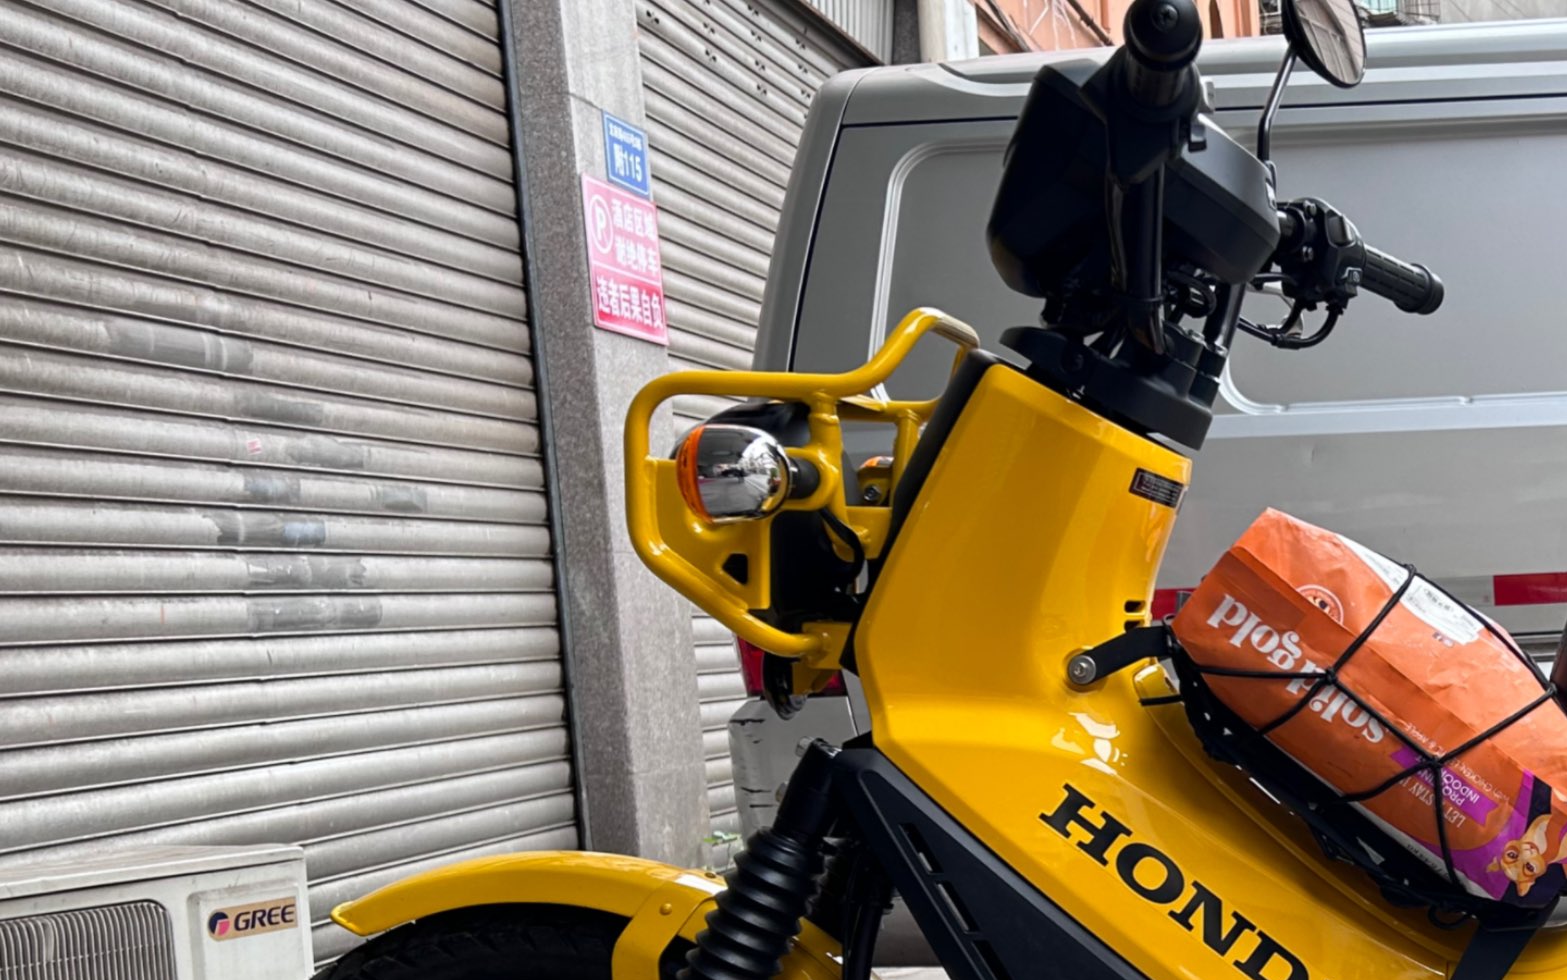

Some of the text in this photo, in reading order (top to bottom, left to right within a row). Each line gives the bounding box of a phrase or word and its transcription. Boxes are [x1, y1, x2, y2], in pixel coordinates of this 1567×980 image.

[614, 235, 659, 276] 谢绝停车
[596, 275, 663, 329] 违者后果自负
[1206, 593, 1385, 743] solid gold
[1407, 780, 1436, 807] STAY
[234, 904, 295, 932] GREE
